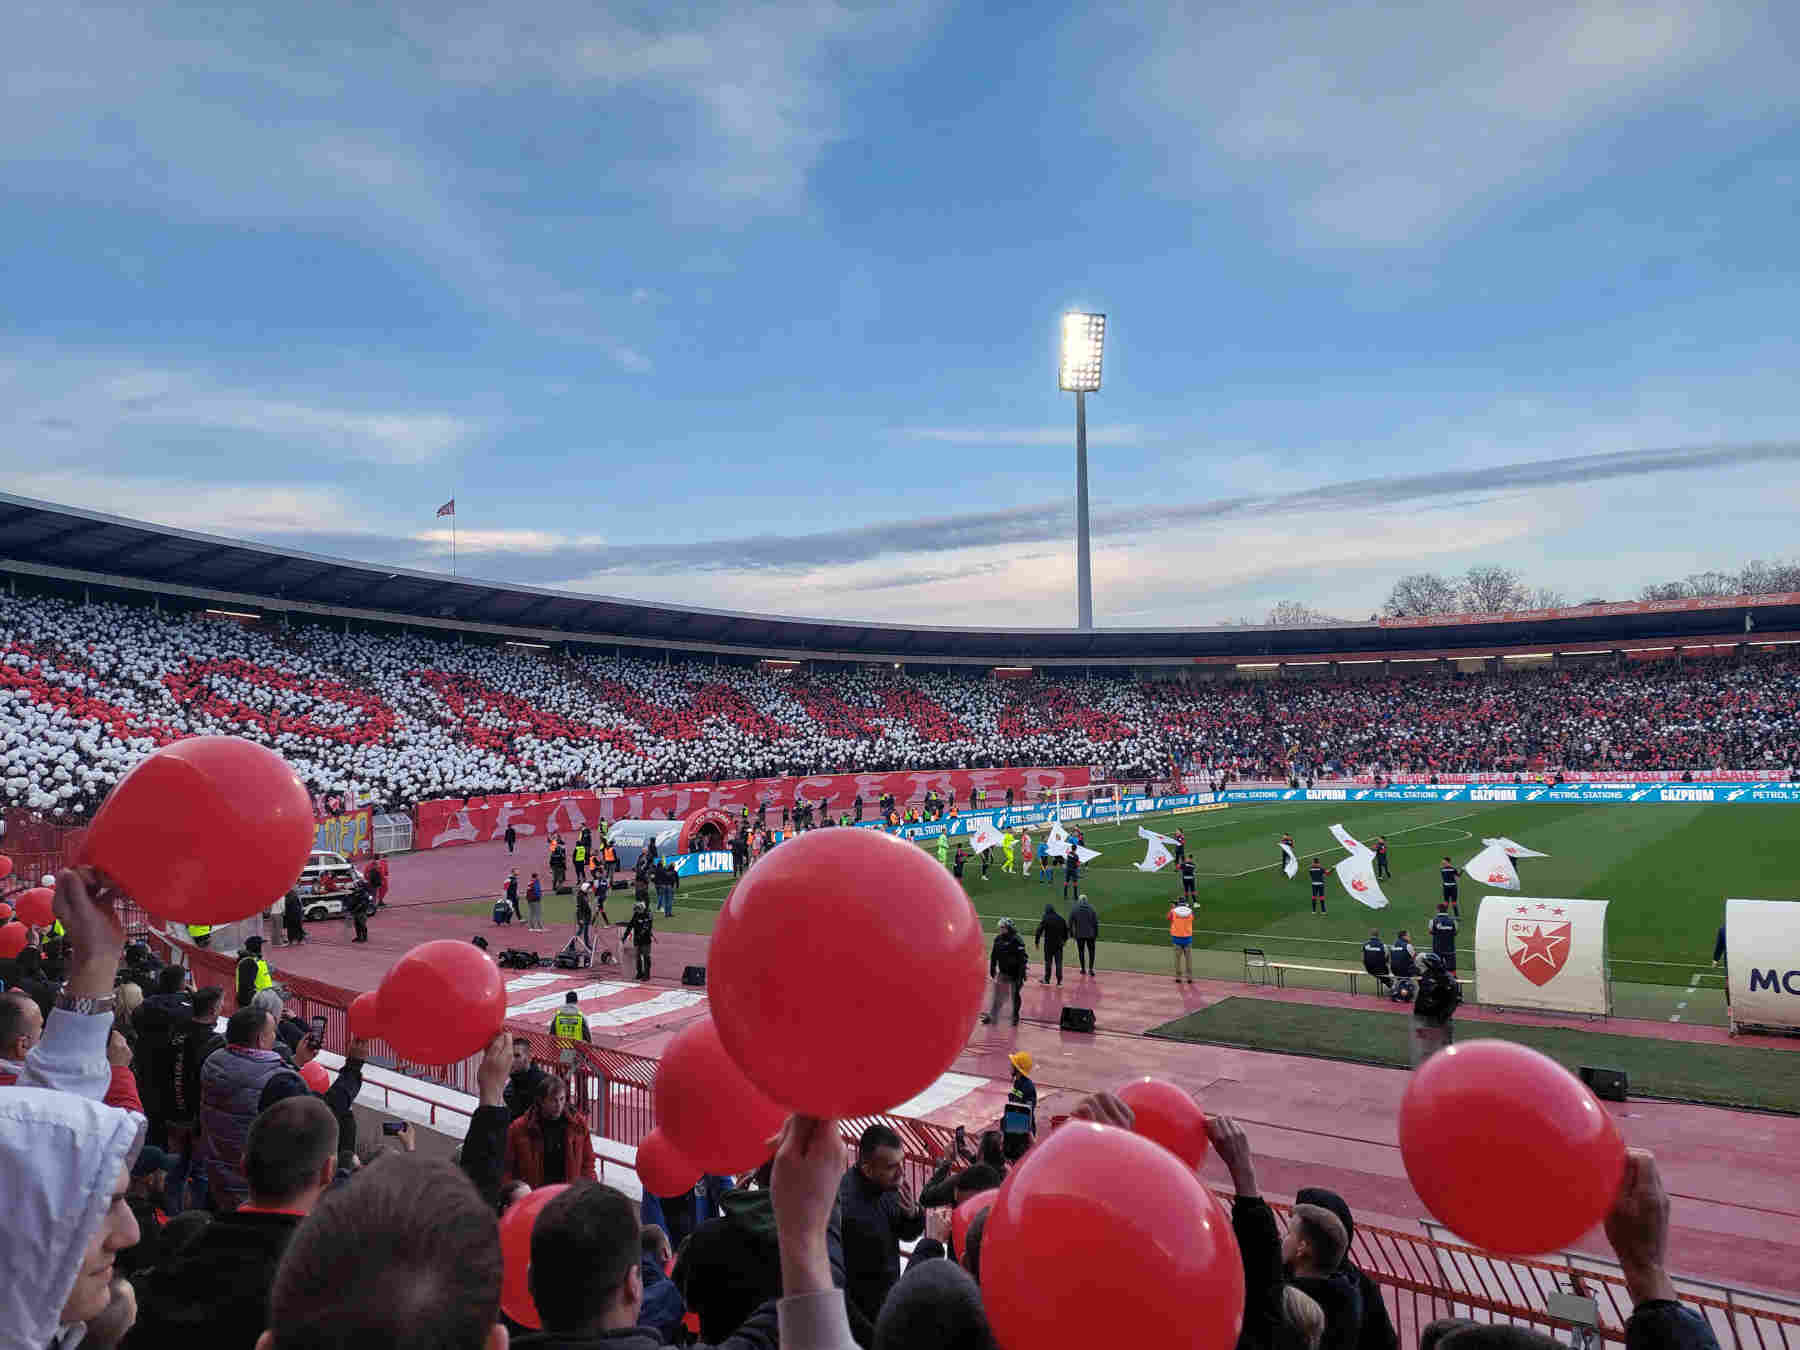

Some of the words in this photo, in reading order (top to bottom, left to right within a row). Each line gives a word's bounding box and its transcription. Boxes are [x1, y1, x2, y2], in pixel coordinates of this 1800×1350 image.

[1306, 789, 1347, 800] GAZPROM
[1374, 791, 1403, 799] PETROL
[1404, 791, 1439, 799] STATIONS
[1470, 789, 1517, 800] GAZPROM
[1549, 791, 1581, 799] PETROL
[1582, 791, 1623, 799] STATIONS
[1660, 789, 1714, 800] GAZPROM
[1753, 791, 1789, 799] PETROL
